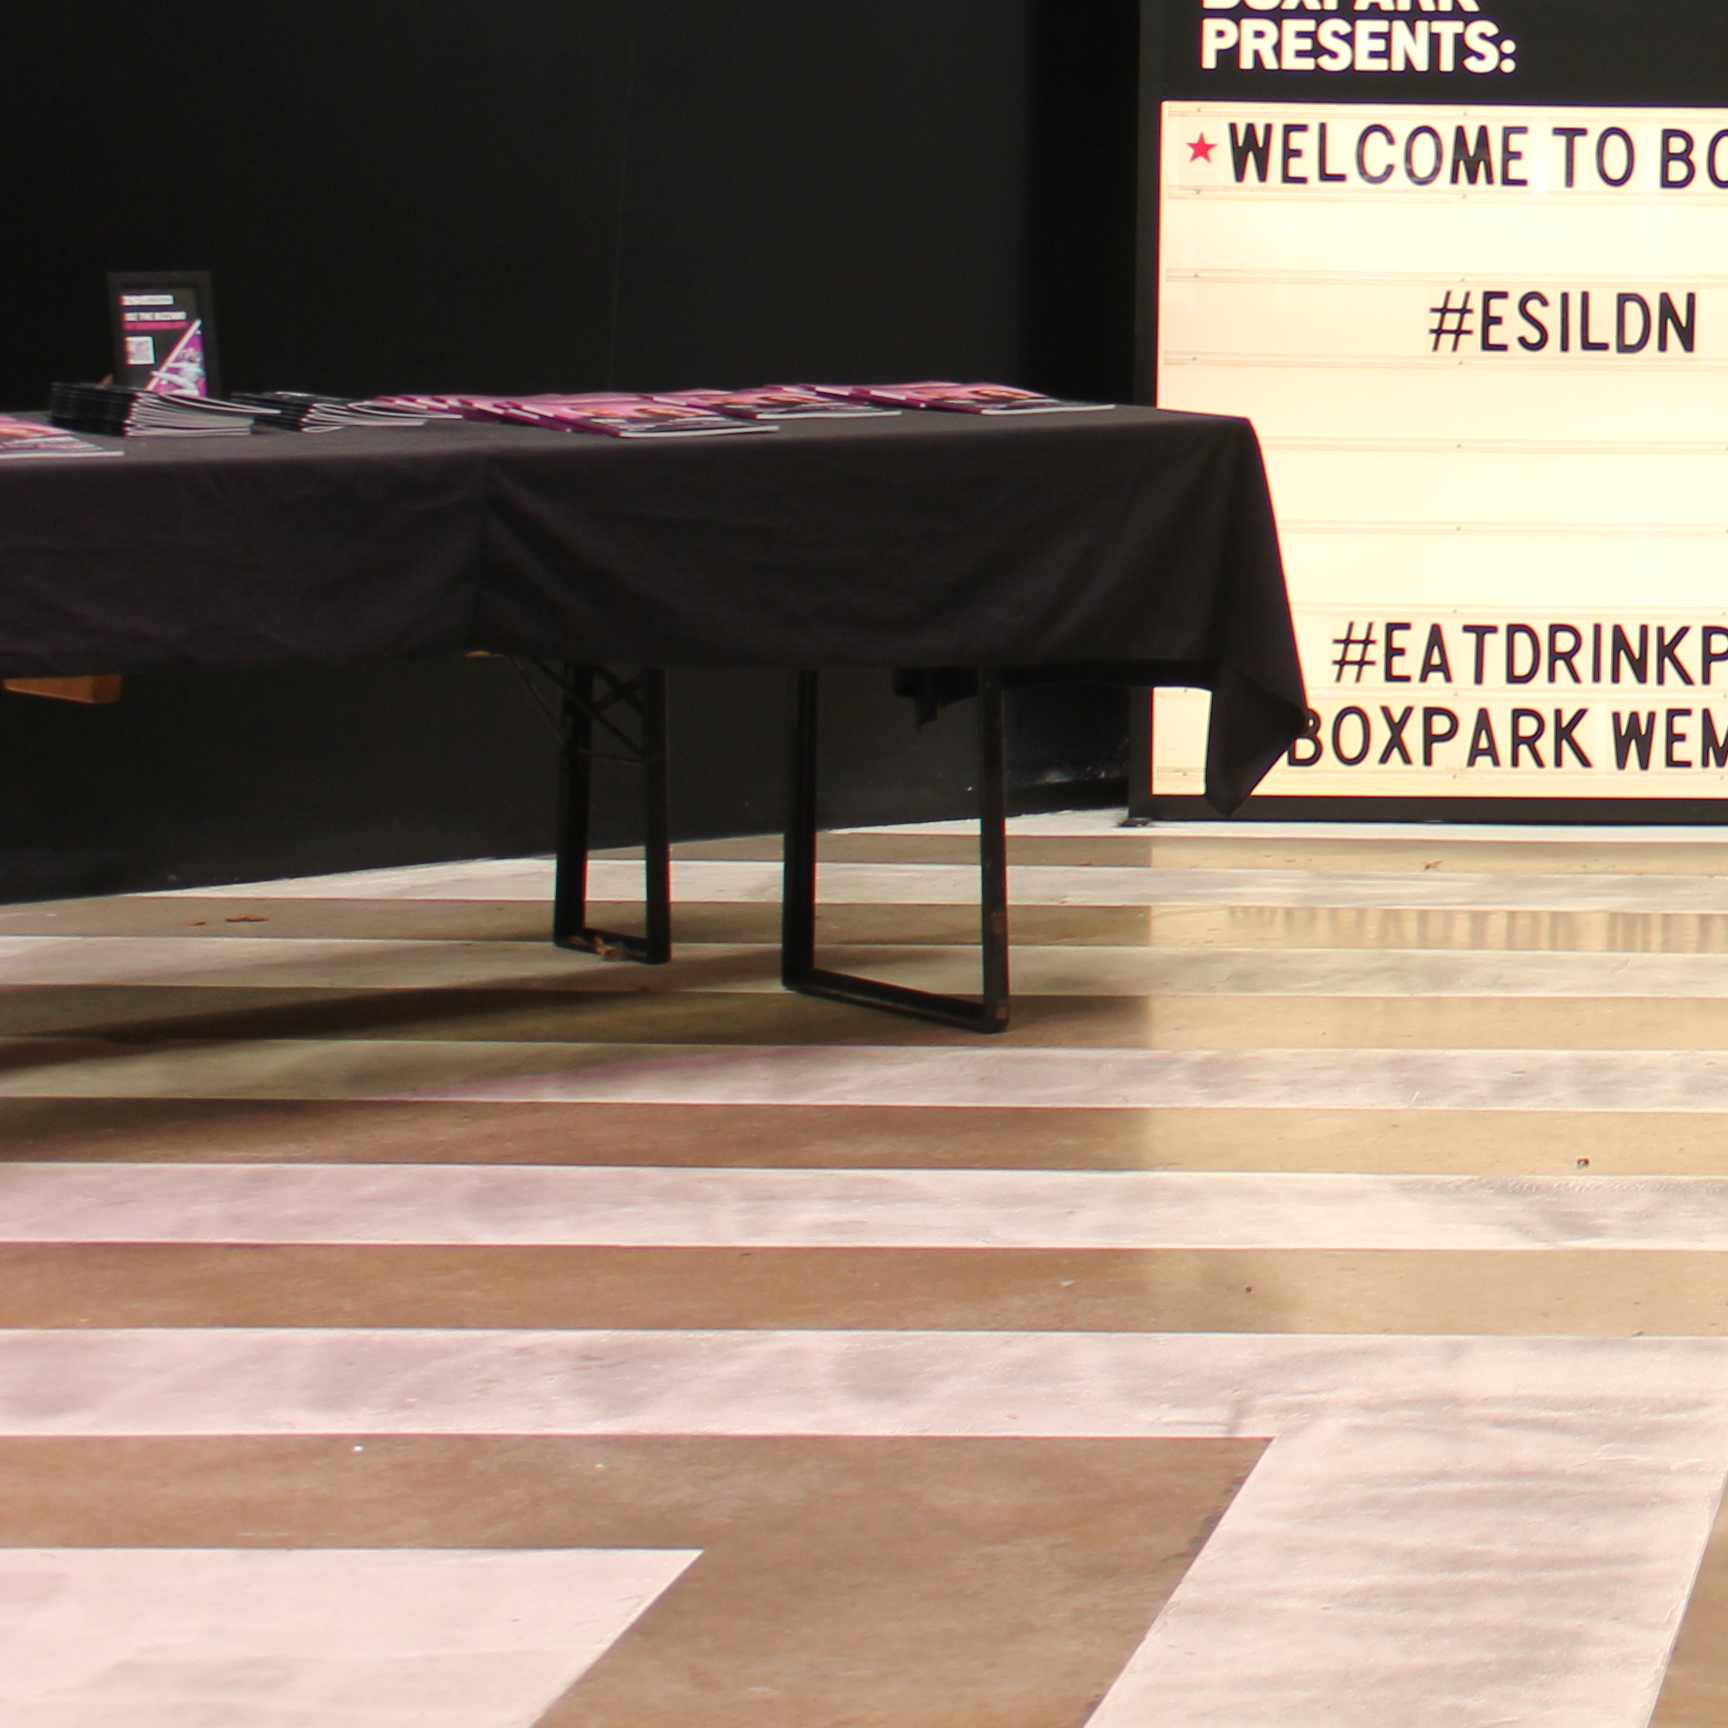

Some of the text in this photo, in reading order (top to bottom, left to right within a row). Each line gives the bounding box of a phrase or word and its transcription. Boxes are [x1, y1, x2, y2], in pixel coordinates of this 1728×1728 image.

[1202, 19, 1517, 74] PRESENTS:
[1228, 121, 1529, 188] WELCOME
[1553, 126, 1635, 189] TO
[1430, 290, 1697, 355] #ESILDN
[1286, 706, 1593, 769] BOXPARK
